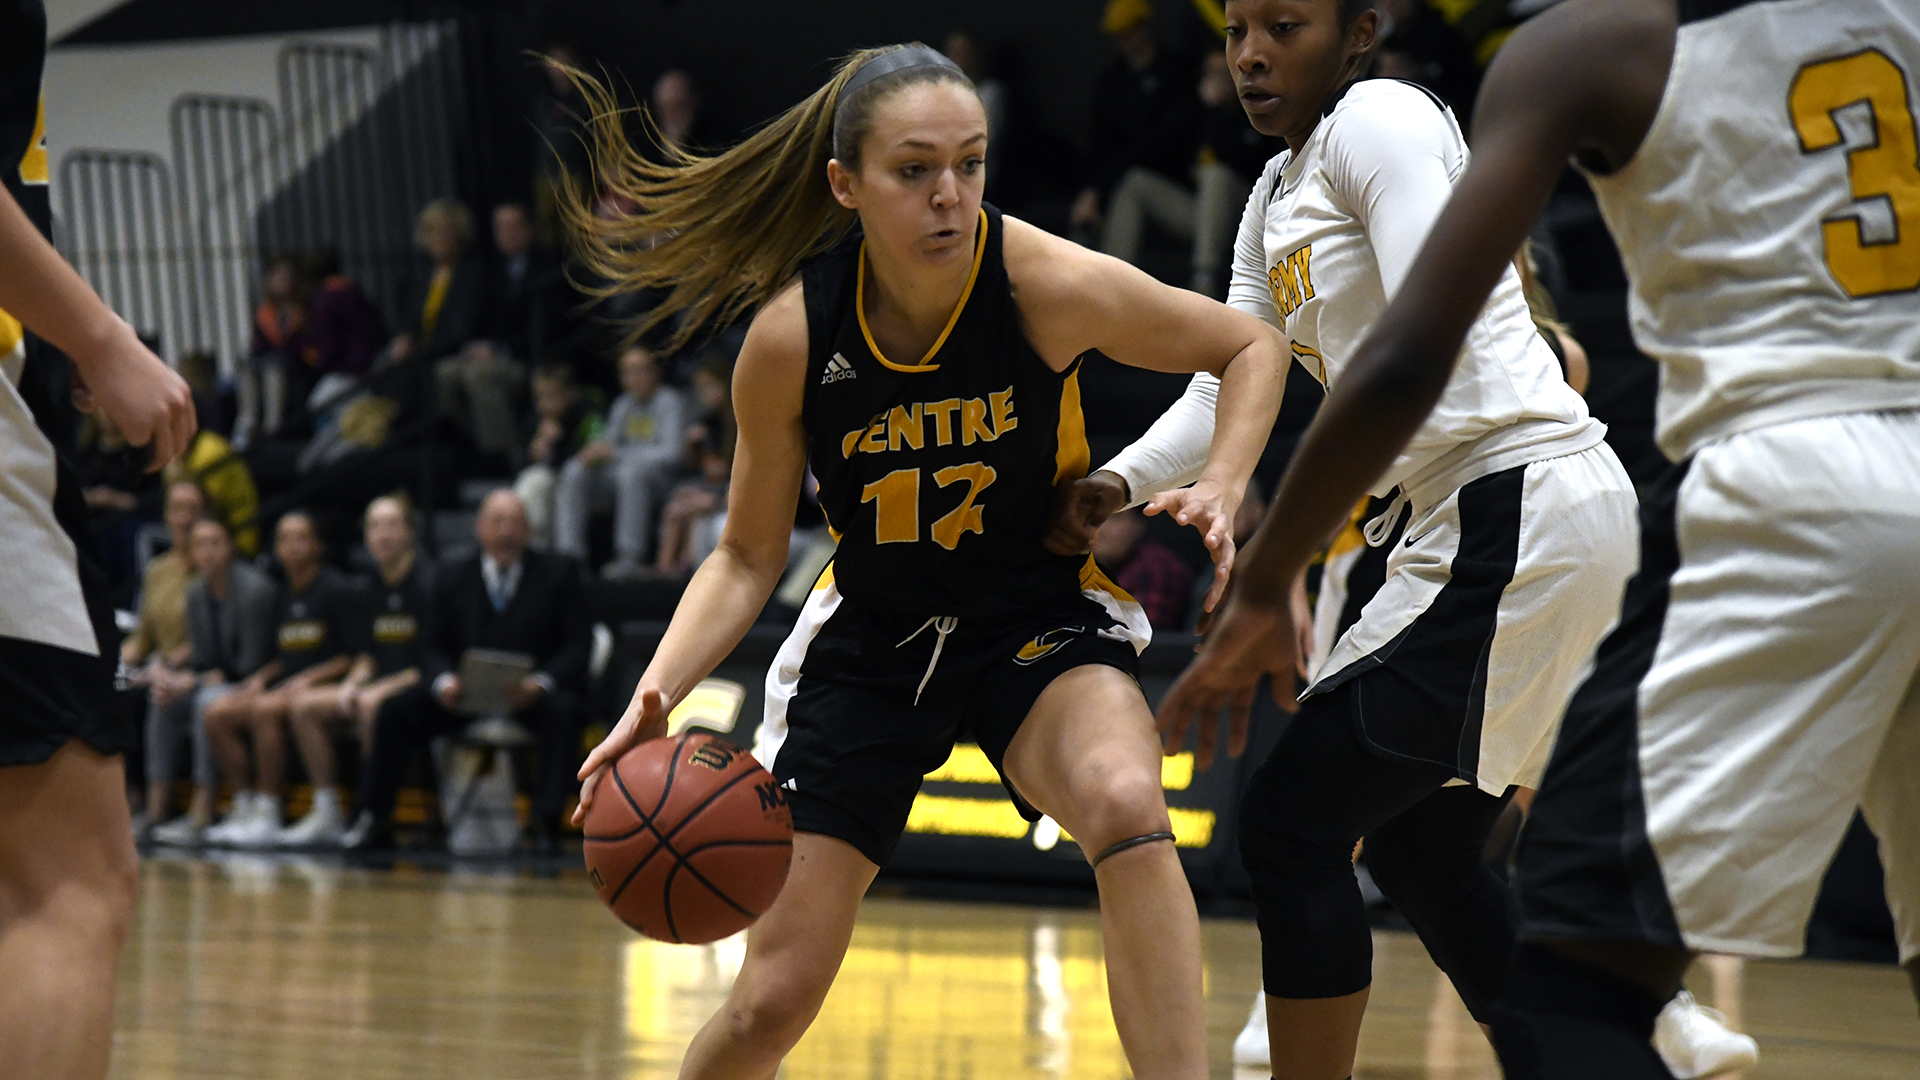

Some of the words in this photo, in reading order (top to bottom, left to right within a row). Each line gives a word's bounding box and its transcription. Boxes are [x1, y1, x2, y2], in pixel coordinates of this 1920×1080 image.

[1787, 47, 1920, 299] 3
[1267, 243, 1316, 329] RMY
[861, 461, 997, 550] 12
